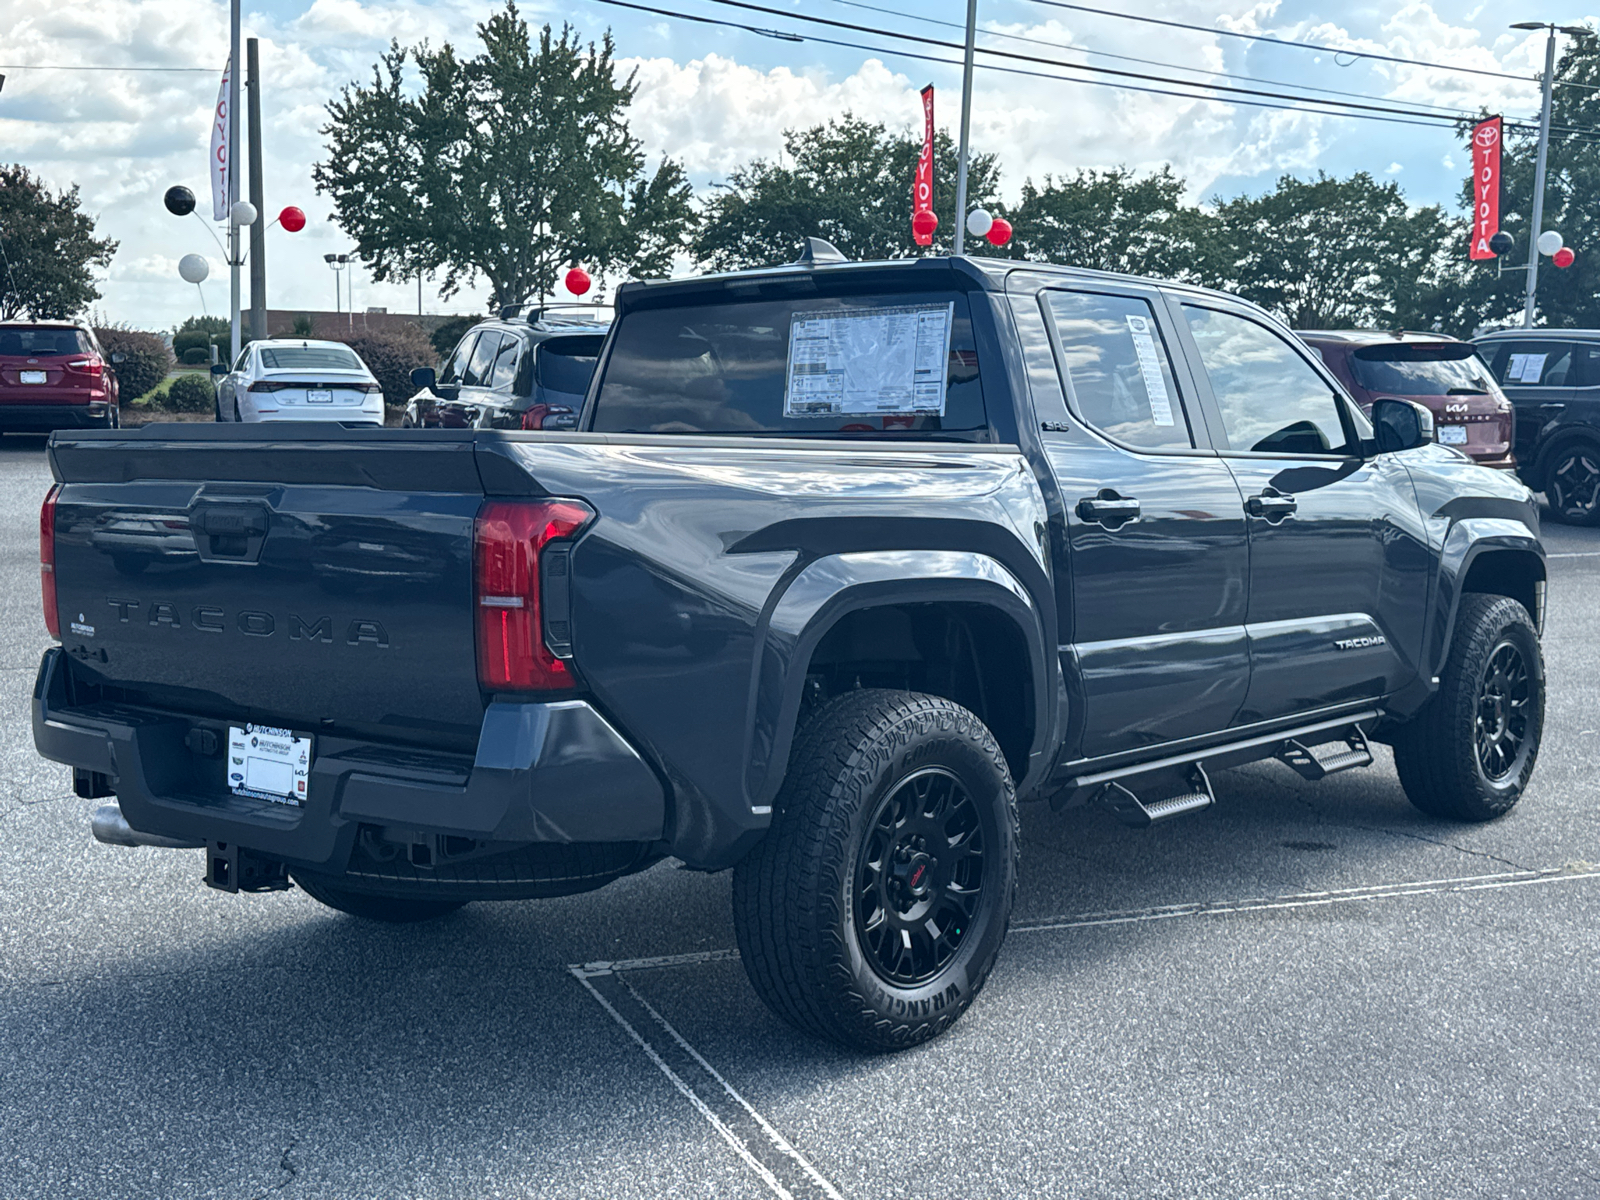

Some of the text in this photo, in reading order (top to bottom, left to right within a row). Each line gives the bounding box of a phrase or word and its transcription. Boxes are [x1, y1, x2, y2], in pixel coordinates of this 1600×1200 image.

[217, 79, 228, 207] TOYOTA
[1477, 149, 1492, 253] TOYOTA
[1446, 404, 1468, 412] KIA
[106, 596, 389, 648] TACOMA
[1334, 636, 1386, 649] TACOMA
[253, 725, 292, 737] HUTCHINSON
[259, 740, 291, 751] HUTCHINSON
[865, 977, 961, 1018] WRANGLER
